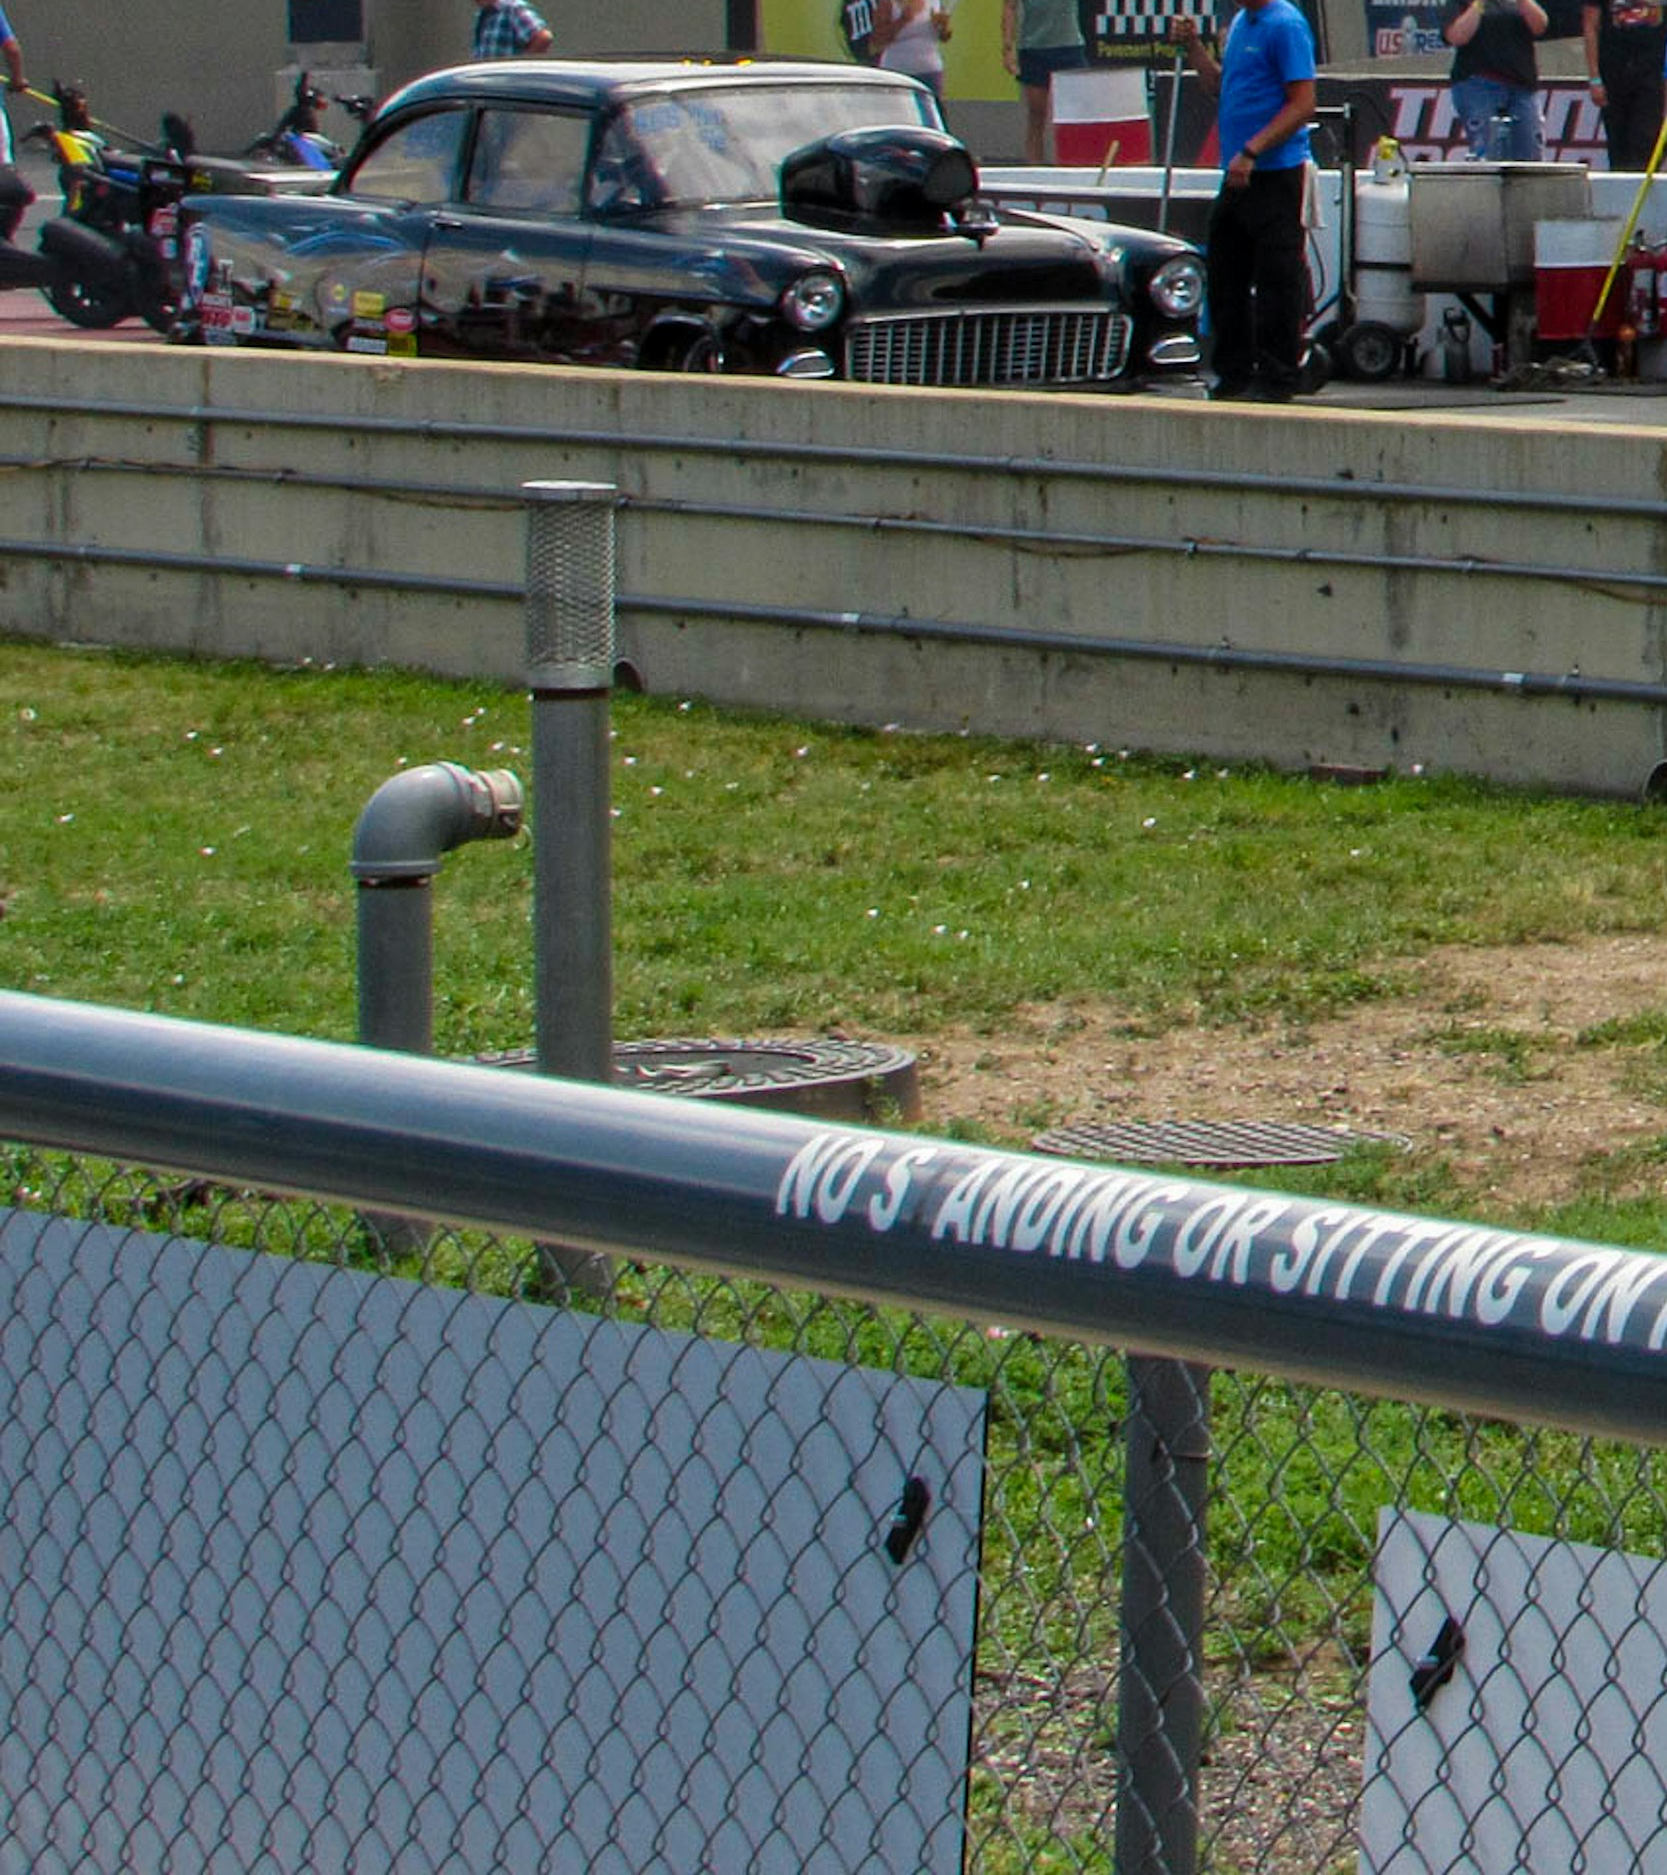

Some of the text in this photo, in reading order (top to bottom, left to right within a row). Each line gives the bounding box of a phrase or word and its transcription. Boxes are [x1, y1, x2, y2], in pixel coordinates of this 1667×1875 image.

[776, 1133, 885, 1224] NO
[1173, 1193, 1293, 1285] OR
[1270, 1206, 1559, 1326] SITTING
